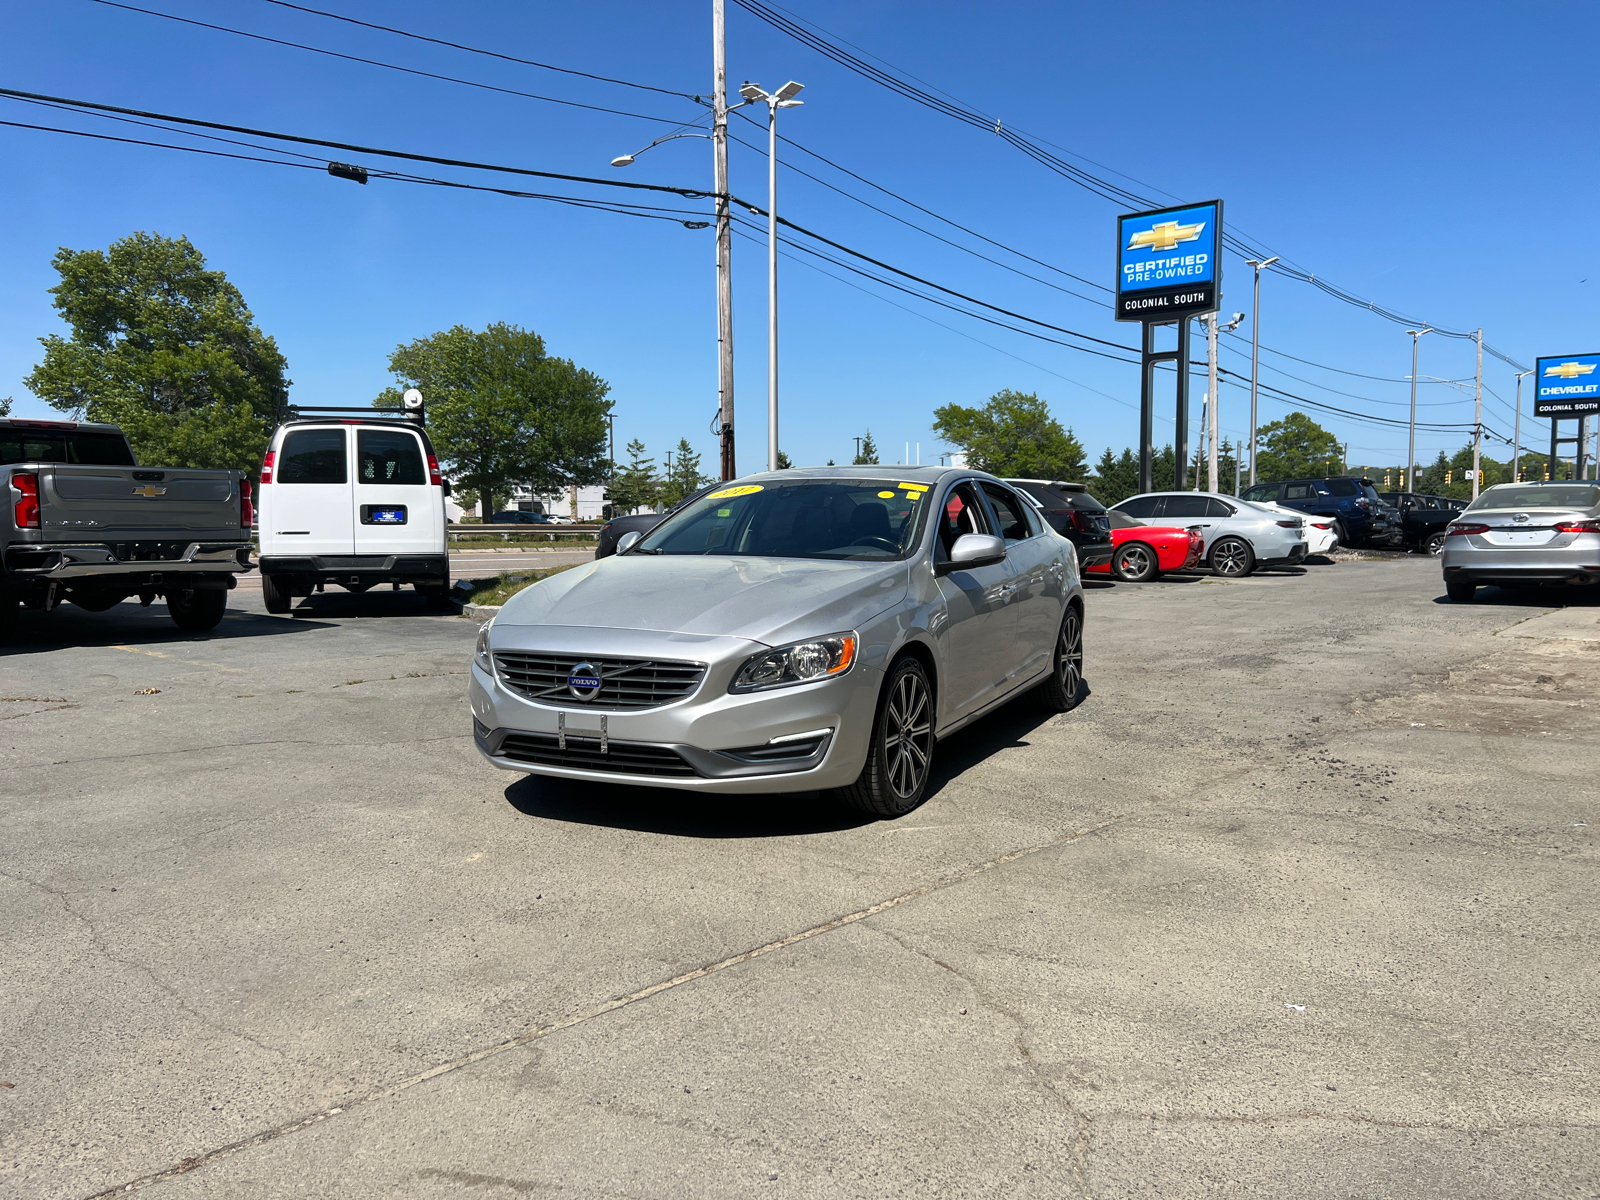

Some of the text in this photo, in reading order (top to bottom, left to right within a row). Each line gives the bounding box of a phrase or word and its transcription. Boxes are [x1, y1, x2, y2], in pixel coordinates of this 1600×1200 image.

[1124, 253, 1208, 274] CERTIFIED
[1127, 265, 1203, 283] PRE-OWNED
[1125, 292, 1205, 310] COLONIAL SOUTH
[1540, 384, 1599, 396] CHEVROLET
[1539, 404, 1573, 412] COLONIAL
[571, 678, 598, 686] VOLVO
